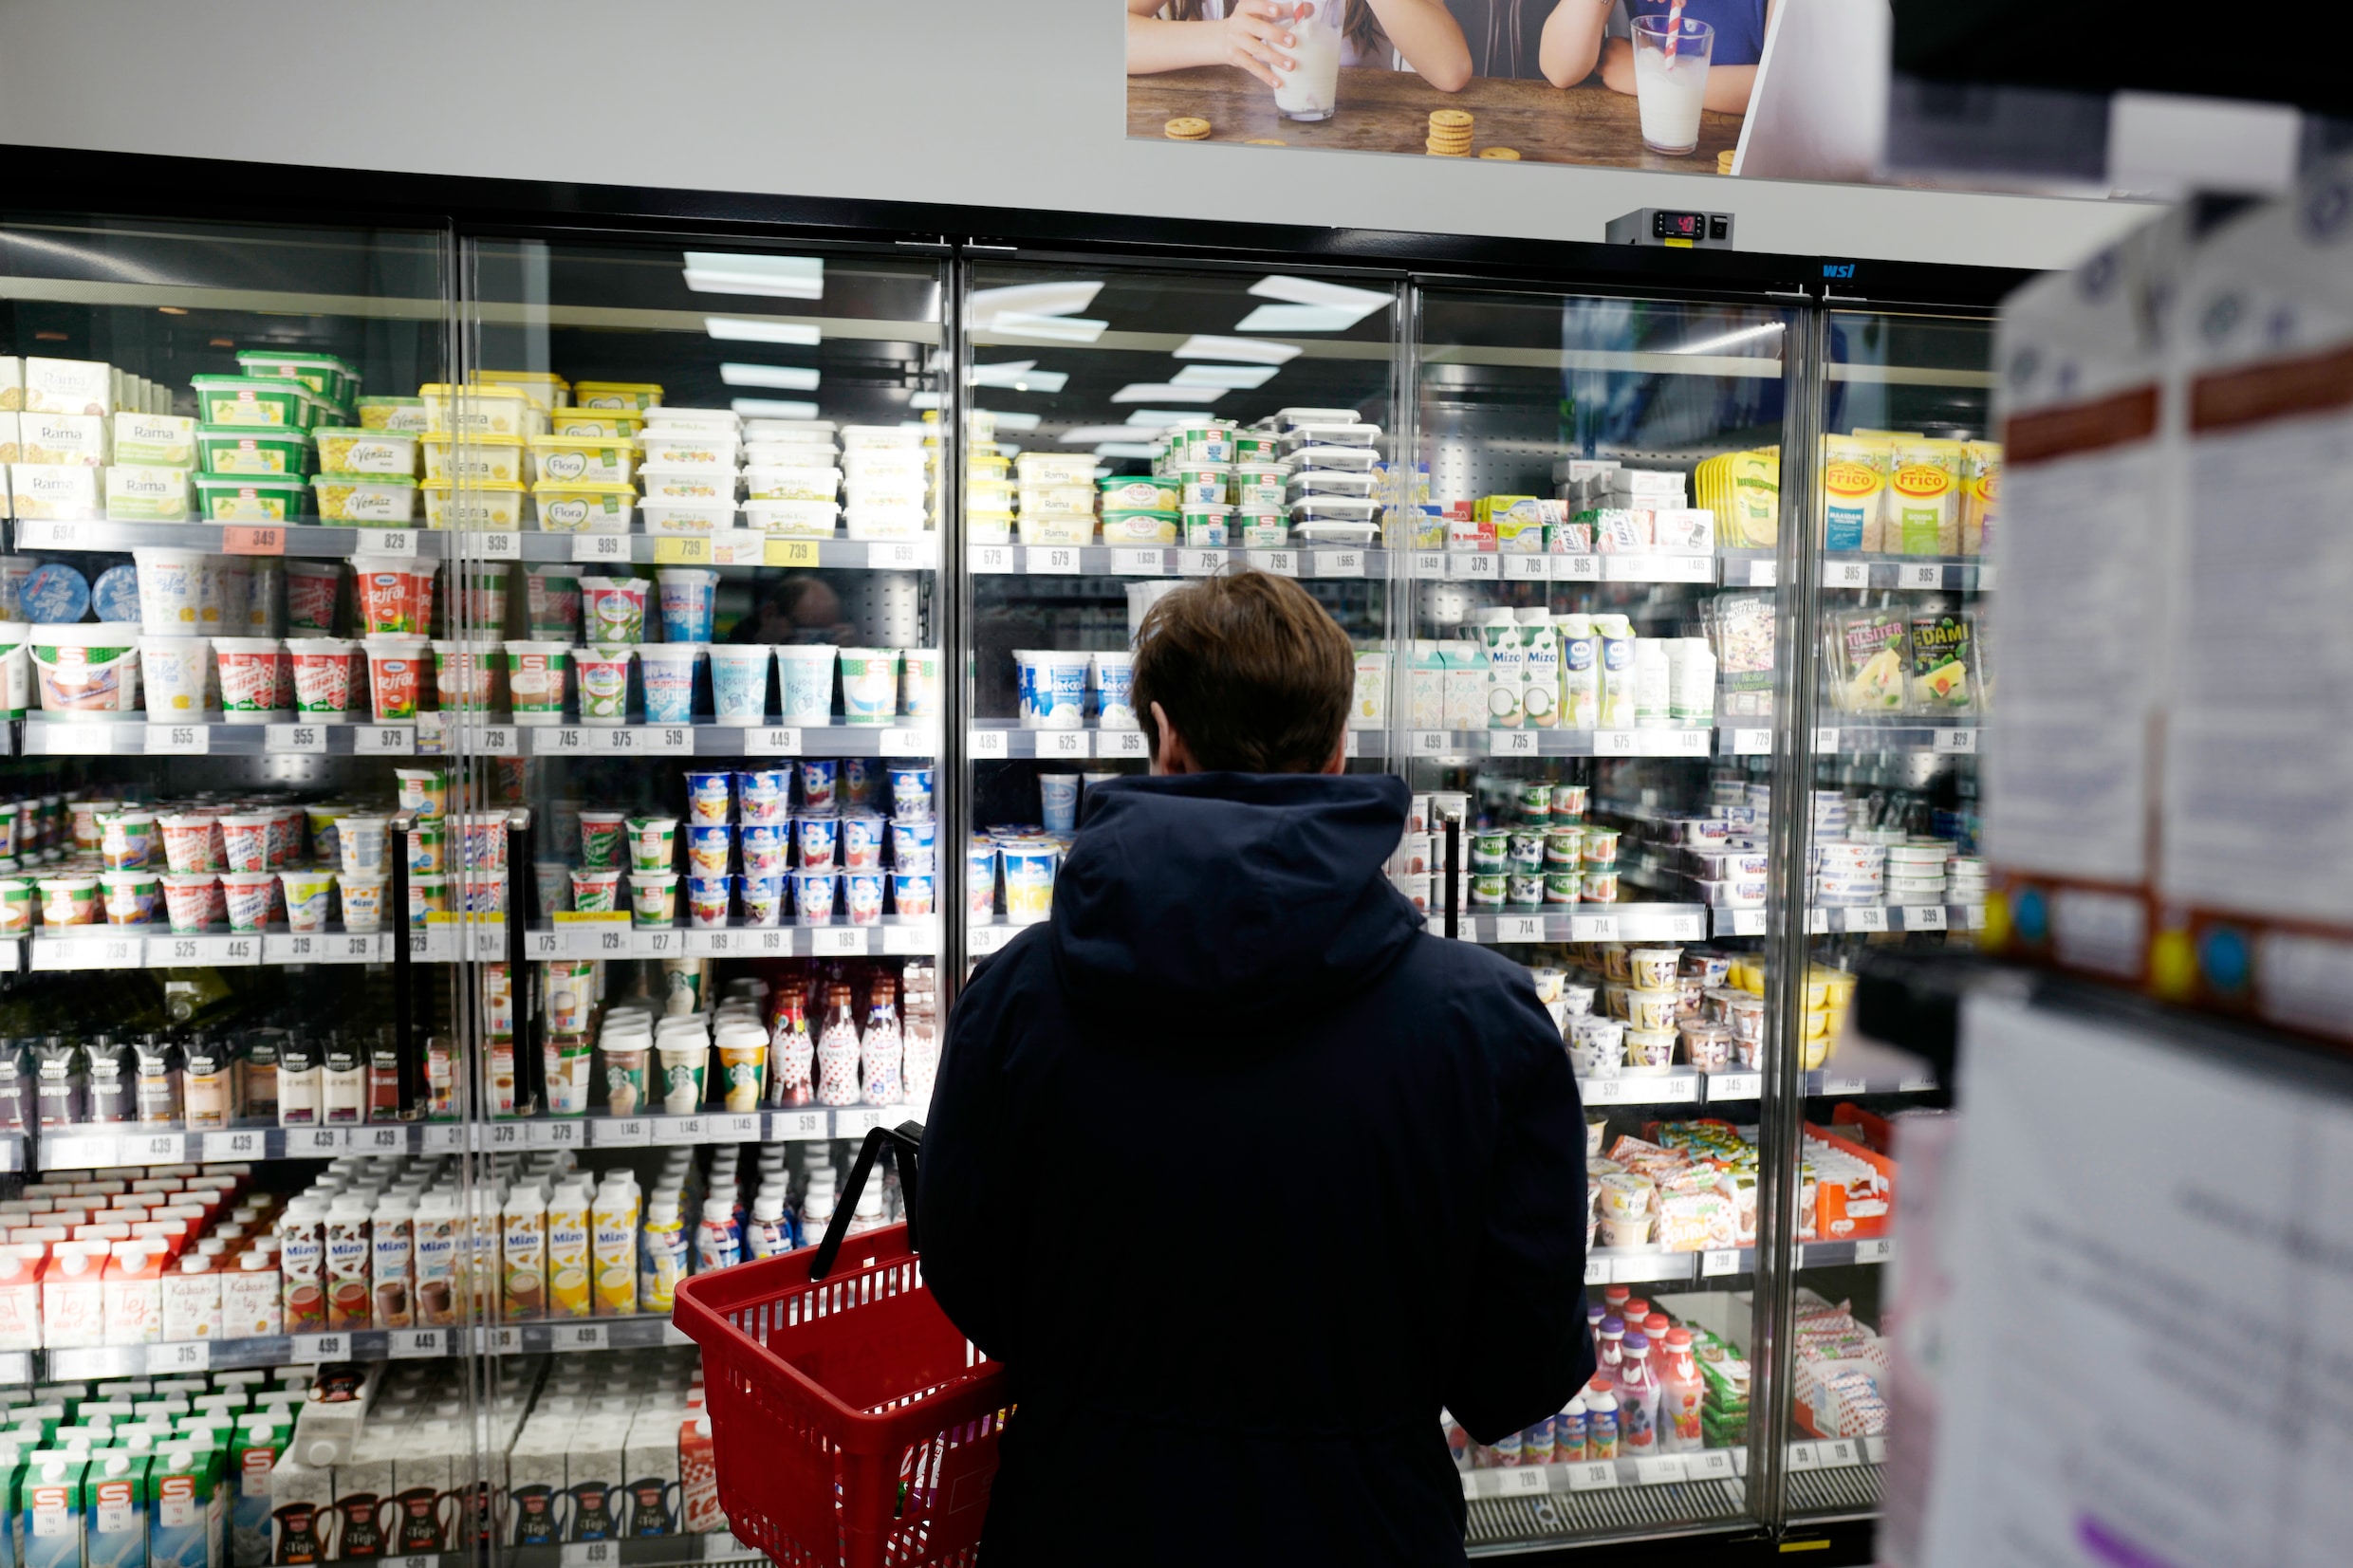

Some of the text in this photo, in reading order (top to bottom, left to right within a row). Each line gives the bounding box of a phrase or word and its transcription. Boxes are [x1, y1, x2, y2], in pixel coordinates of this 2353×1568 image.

[42, 427, 83, 440] Rama
[134, 426, 175, 440] Rama
[552, 460, 581, 471] Flora
[1045, 470, 1069, 480] Rama
[1827, 471, 1871, 487] Frico
[1899, 471, 1943, 487] Frico
[33, 477, 74, 490] Rama
[126, 479, 166, 492] Rama
[1045, 500, 1070, 509] Rama
[554, 507, 583, 519] Flora
[252, 530, 275, 545] 349
[384, 533, 405, 549] 829
[1045, 529, 1070, 539] Rama
[488, 535, 508, 550] 939
[598, 538, 618, 553] 989
[681, 541, 700, 556] 739
[788, 544, 807, 559] 739
[895, 546, 913, 561] 699
[984, 550, 1002, 565] 679
[1051, 551, 1069, 566] 679
[1201, 553, 1218, 568] 799
[1270, 553, 1288, 568] 799
[1472, 557, 1488, 572] 379
[1526, 558, 1542, 573] 709
[1574, 558, 1590, 573] 985
[1844, 566, 1860, 581] 985
[1918, 568, 1934, 582] 985
[1845, 622, 1902, 646] TILSITER
[1913, 623, 1969, 646] EDAMI
[1492, 652, 1522, 663] Mizo
[1528, 652, 1557, 663] Mizo
[172, 729, 193, 745] 655
[293, 729, 314, 745] 955
[381, 730, 401, 747] 979
[486, 731, 505, 747] 739
[559, 730, 578, 747] 745
[613, 730, 632, 747] 975
[666, 729, 682, 746] 519
[770, 731, 789, 747] 449
[979, 734, 997, 748] 489
[1059, 735, 1076, 749] 625
[1122, 735, 1139, 749] 395
[1424, 733, 1441, 748] 499
[1512, 734, 1528, 748] 735
[1615, 734, 1629, 748] 675
[1681, 732, 1697, 747] 449
[1755, 733, 1769, 747] 729
[1863, 911, 1878, 925] 539
[1922, 909, 1936, 923] 399
[1519, 920, 1534, 934] 714
[1595, 920, 1609, 934] 714
[292, 937, 310, 953] 319
[348, 937, 366, 953] 319
[540, 935, 556, 950] 175
[602, 932, 619, 949] 129
[653, 934, 669, 950] 127
[711, 934, 728, 949] 189
[764, 933, 779, 949] 189
[839, 932, 855, 948] 189
[176, 941, 195, 957] 525
[227, 940, 250, 956] 445
[1670, 1079, 1685, 1095] 345
[1725, 1078, 1741, 1092] 345
[800, 1116, 816, 1130] 519
[863, 1113, 880, 1127] 519
[375, 1130, 395, 1146] 439
[495, 1126, 514, 1142] 379
[552, 1124, 571, 1139] 379
[150, 1138, 171, 1153] 439
[232, 1135, 251, 1151] 439
[314, 1132, 334, 1147] 439
[508, 1234, 539, 1246] Mizo
[553, 1231, 584, 1244] Mizo
[598, 1231, 628, 1244] Mizo
[286, 1245, 319, 1257] Mizo
[331, 1243, 363, 1256] Mizo
[376, 1241, 409, 1253] Mizo
[419, 1241, 451, 1253] Mizo
[577, 1327, 597, 1342] 499
[318, 1337, 339, 1353] 499
[178, 1346, 196, 1362] 315
[586, 1544, 608, 1562] 499
